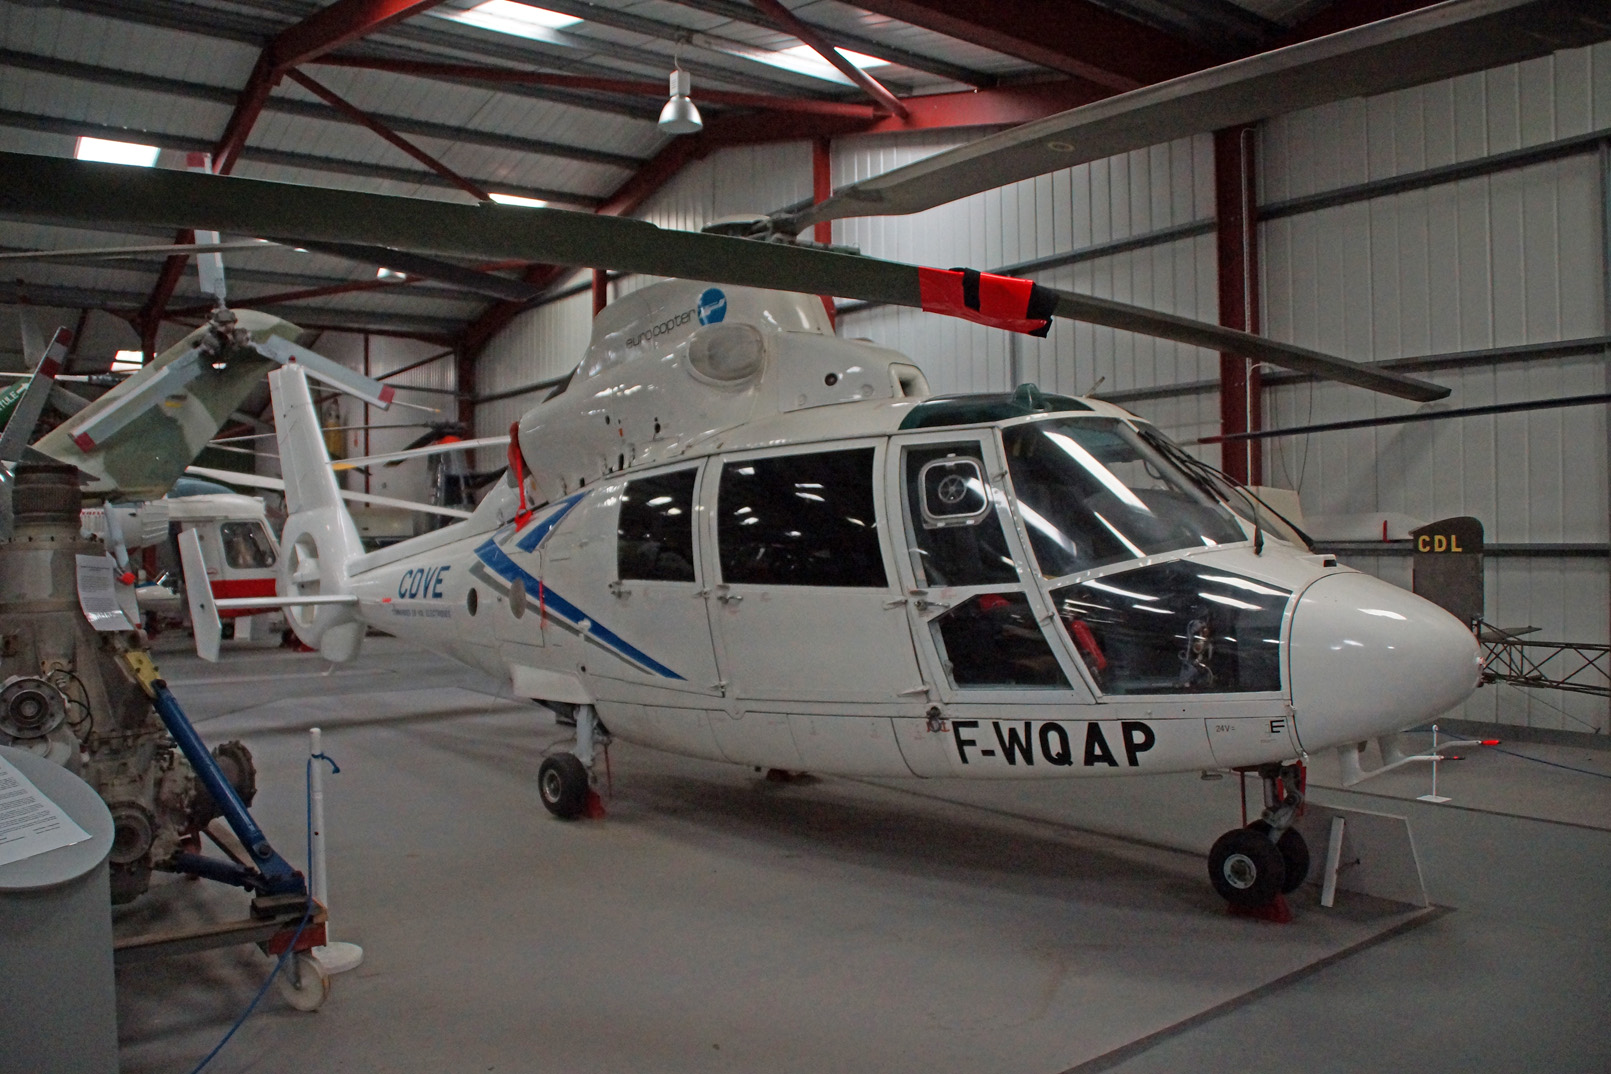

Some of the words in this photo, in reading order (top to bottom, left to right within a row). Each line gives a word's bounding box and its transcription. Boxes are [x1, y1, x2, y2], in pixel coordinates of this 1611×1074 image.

[625, 308, 696, 349] eurocopter
[1418, 534, 1463, 553] CDL
[951, 720, 1156, 767] F-WQAP
